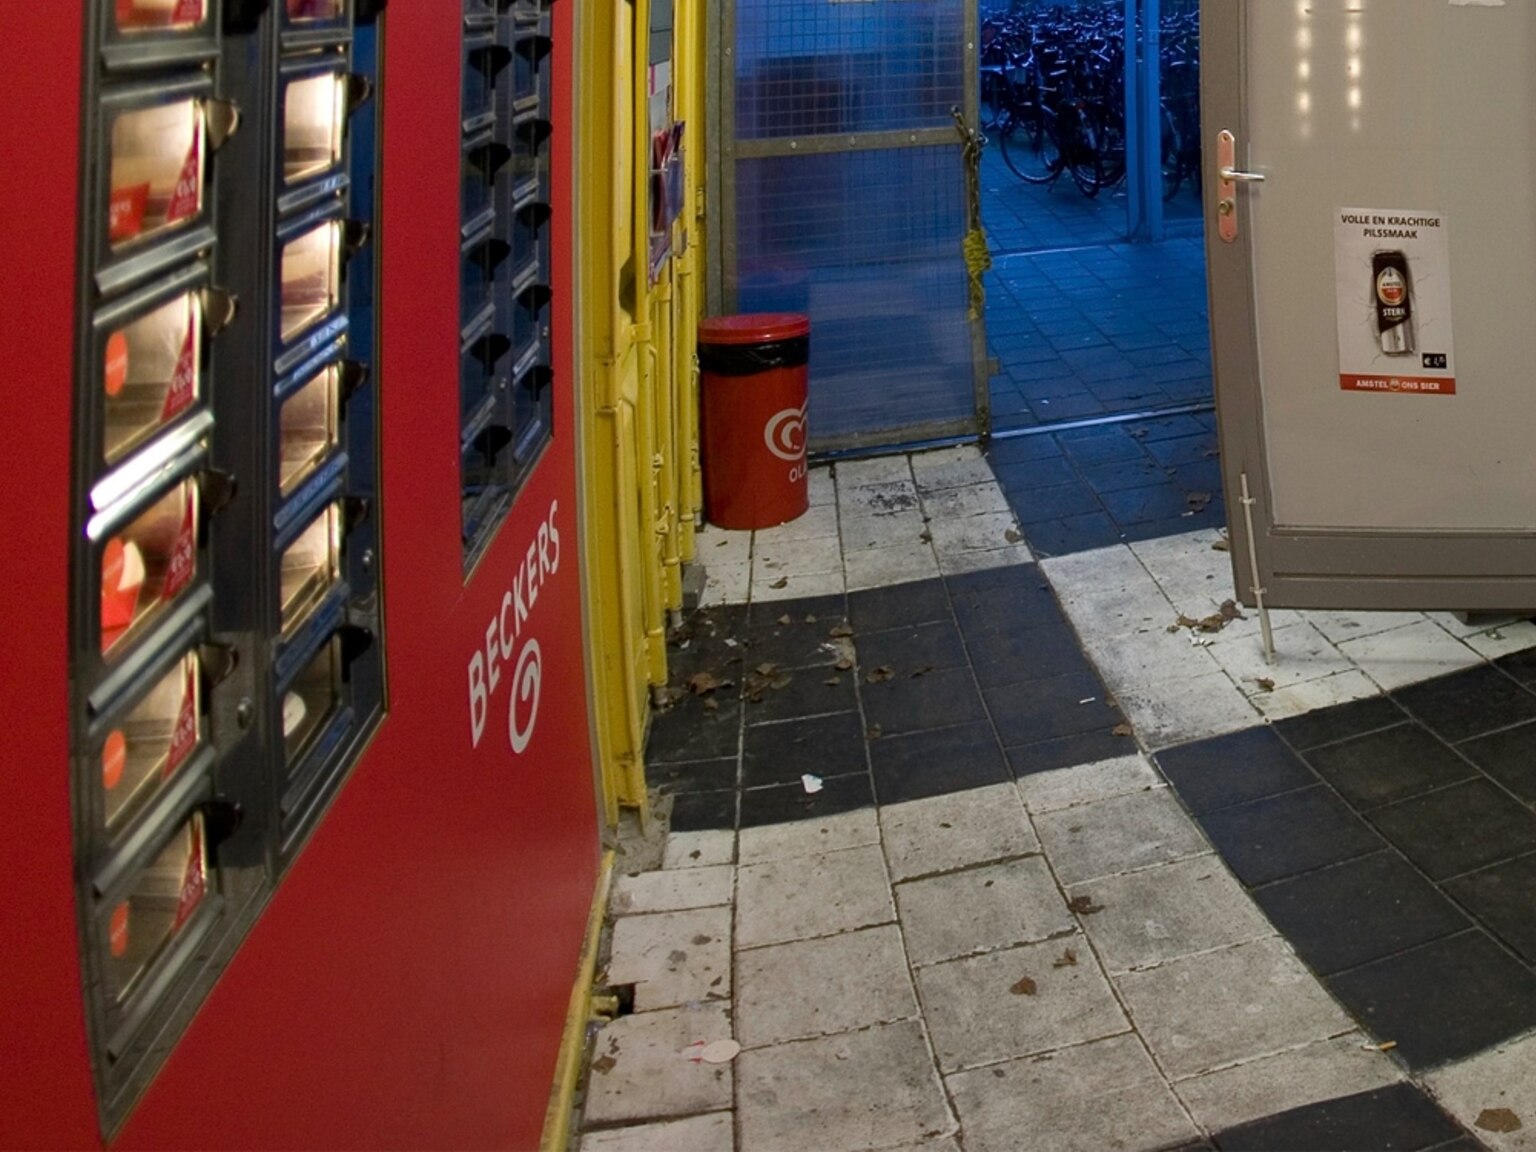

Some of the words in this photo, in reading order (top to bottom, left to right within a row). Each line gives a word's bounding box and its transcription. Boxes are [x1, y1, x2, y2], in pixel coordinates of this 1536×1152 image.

[1341, 214, 1370, 225] VOLLE
[1372, 216, 1386, 226] EN
[1388, 216, 1441, 227] KRACHTIGE
[1363, 229, 1418, 239] PILSSMAAK
[1356, 379, 1389, 389] AMSTEL
[468, 499, 560, 749] BECKERS
